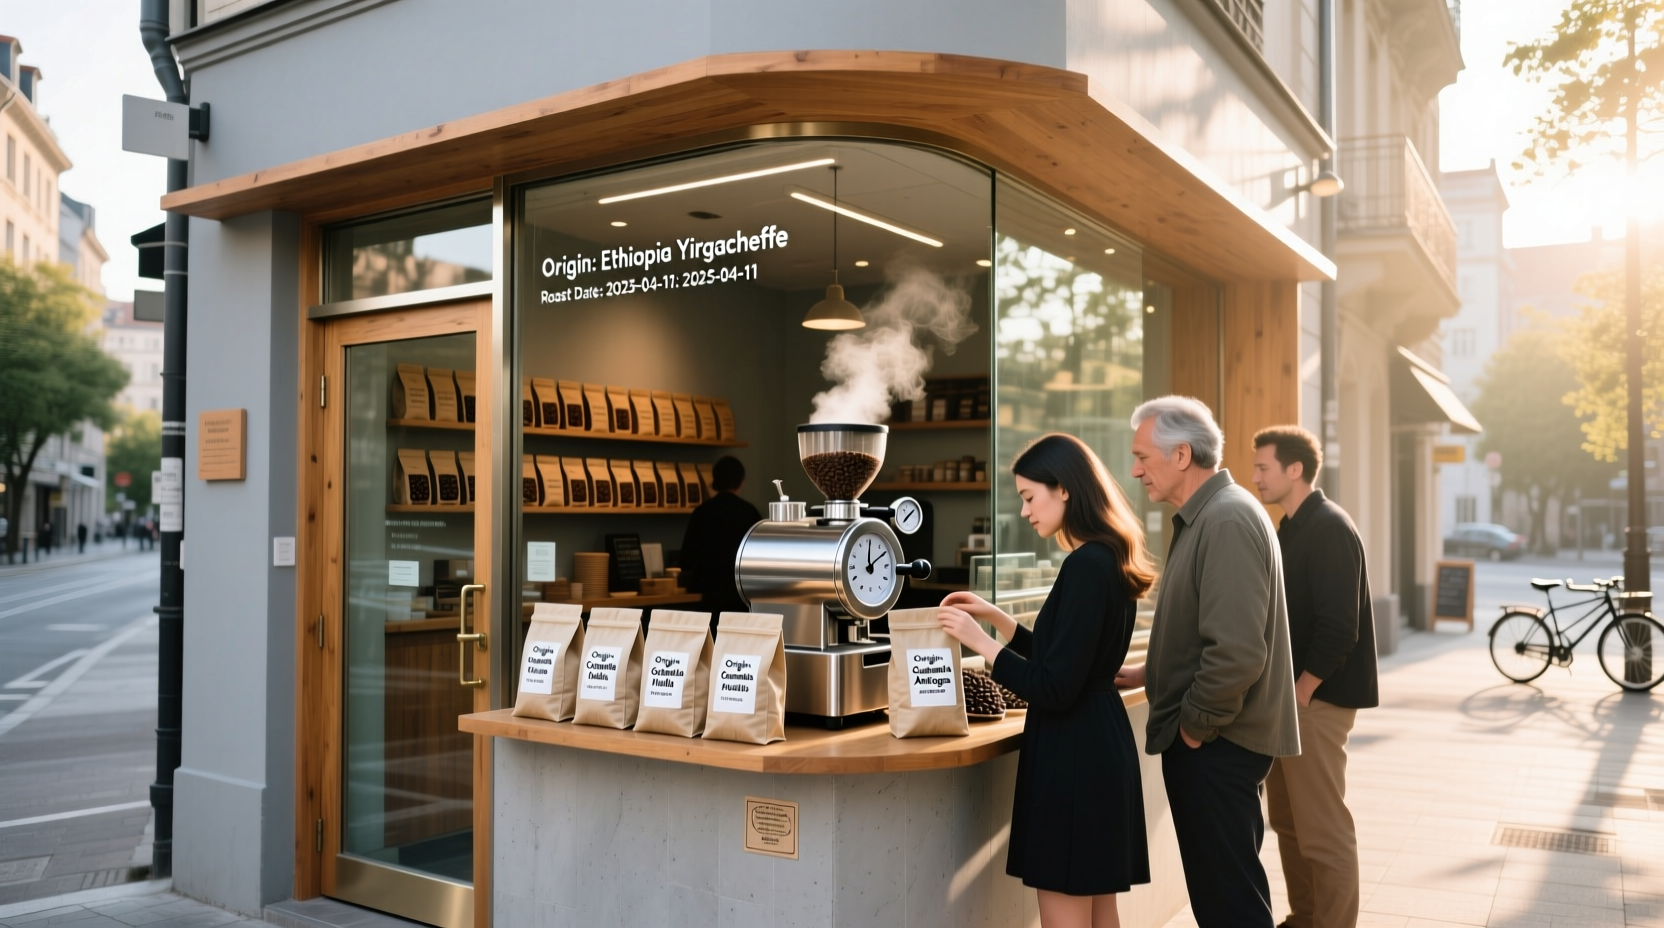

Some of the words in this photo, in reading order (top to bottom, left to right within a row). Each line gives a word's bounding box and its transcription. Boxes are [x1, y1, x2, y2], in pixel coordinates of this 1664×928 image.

[541, 253, 597, 281] Origin:
[601, 241, 672, 271] Ethiopia
[676, 224, 789, 263] Yirgacheffe
[540, 287, 572, 305] Roast
[574, 286, 604, 300] Date:
[682, 262, 758, 288] 2025-04-11
